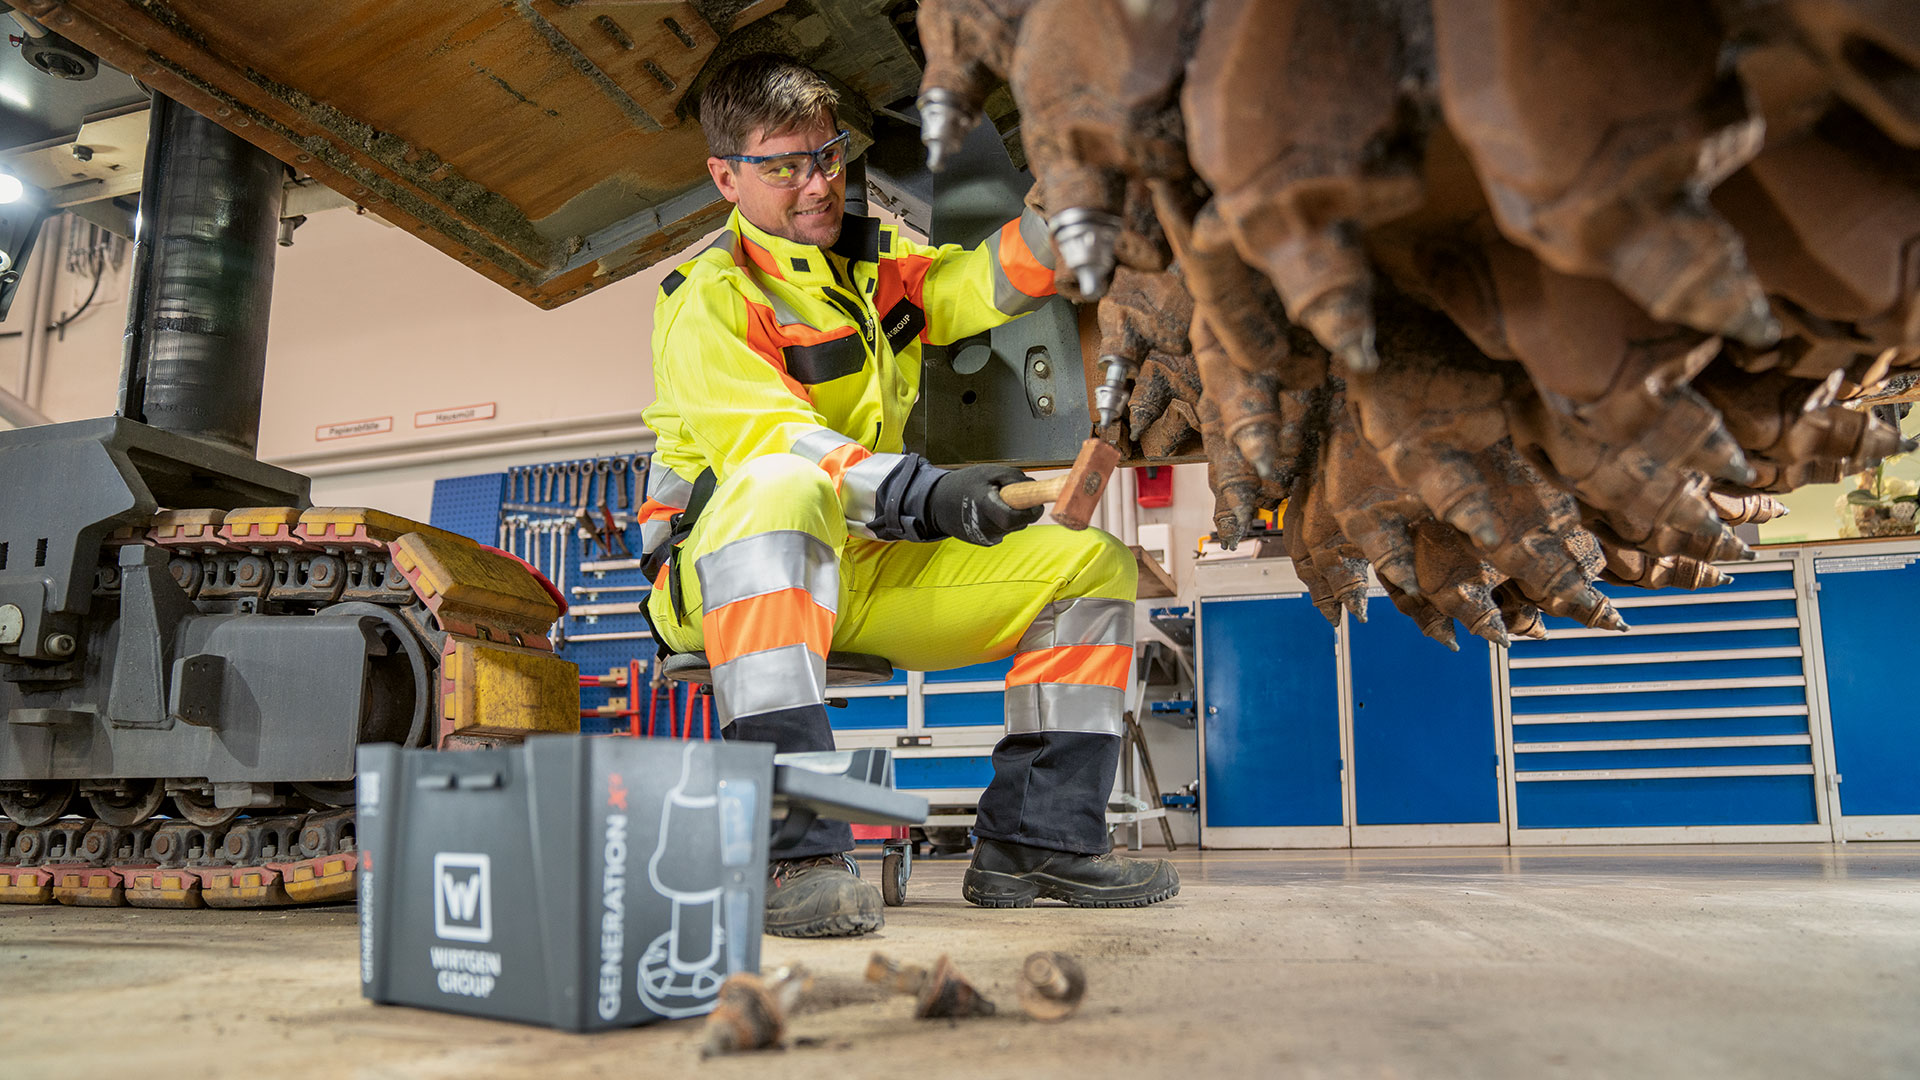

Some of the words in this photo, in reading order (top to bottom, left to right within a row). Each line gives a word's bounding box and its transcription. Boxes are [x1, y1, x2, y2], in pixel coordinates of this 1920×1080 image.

[890, 314, 910, 335] GROUP
[599, 814, 628, 1020] GENERATION
[430, 946, 502, 977] WIRTGEN
[437, 970, 496, 998] GROUP
